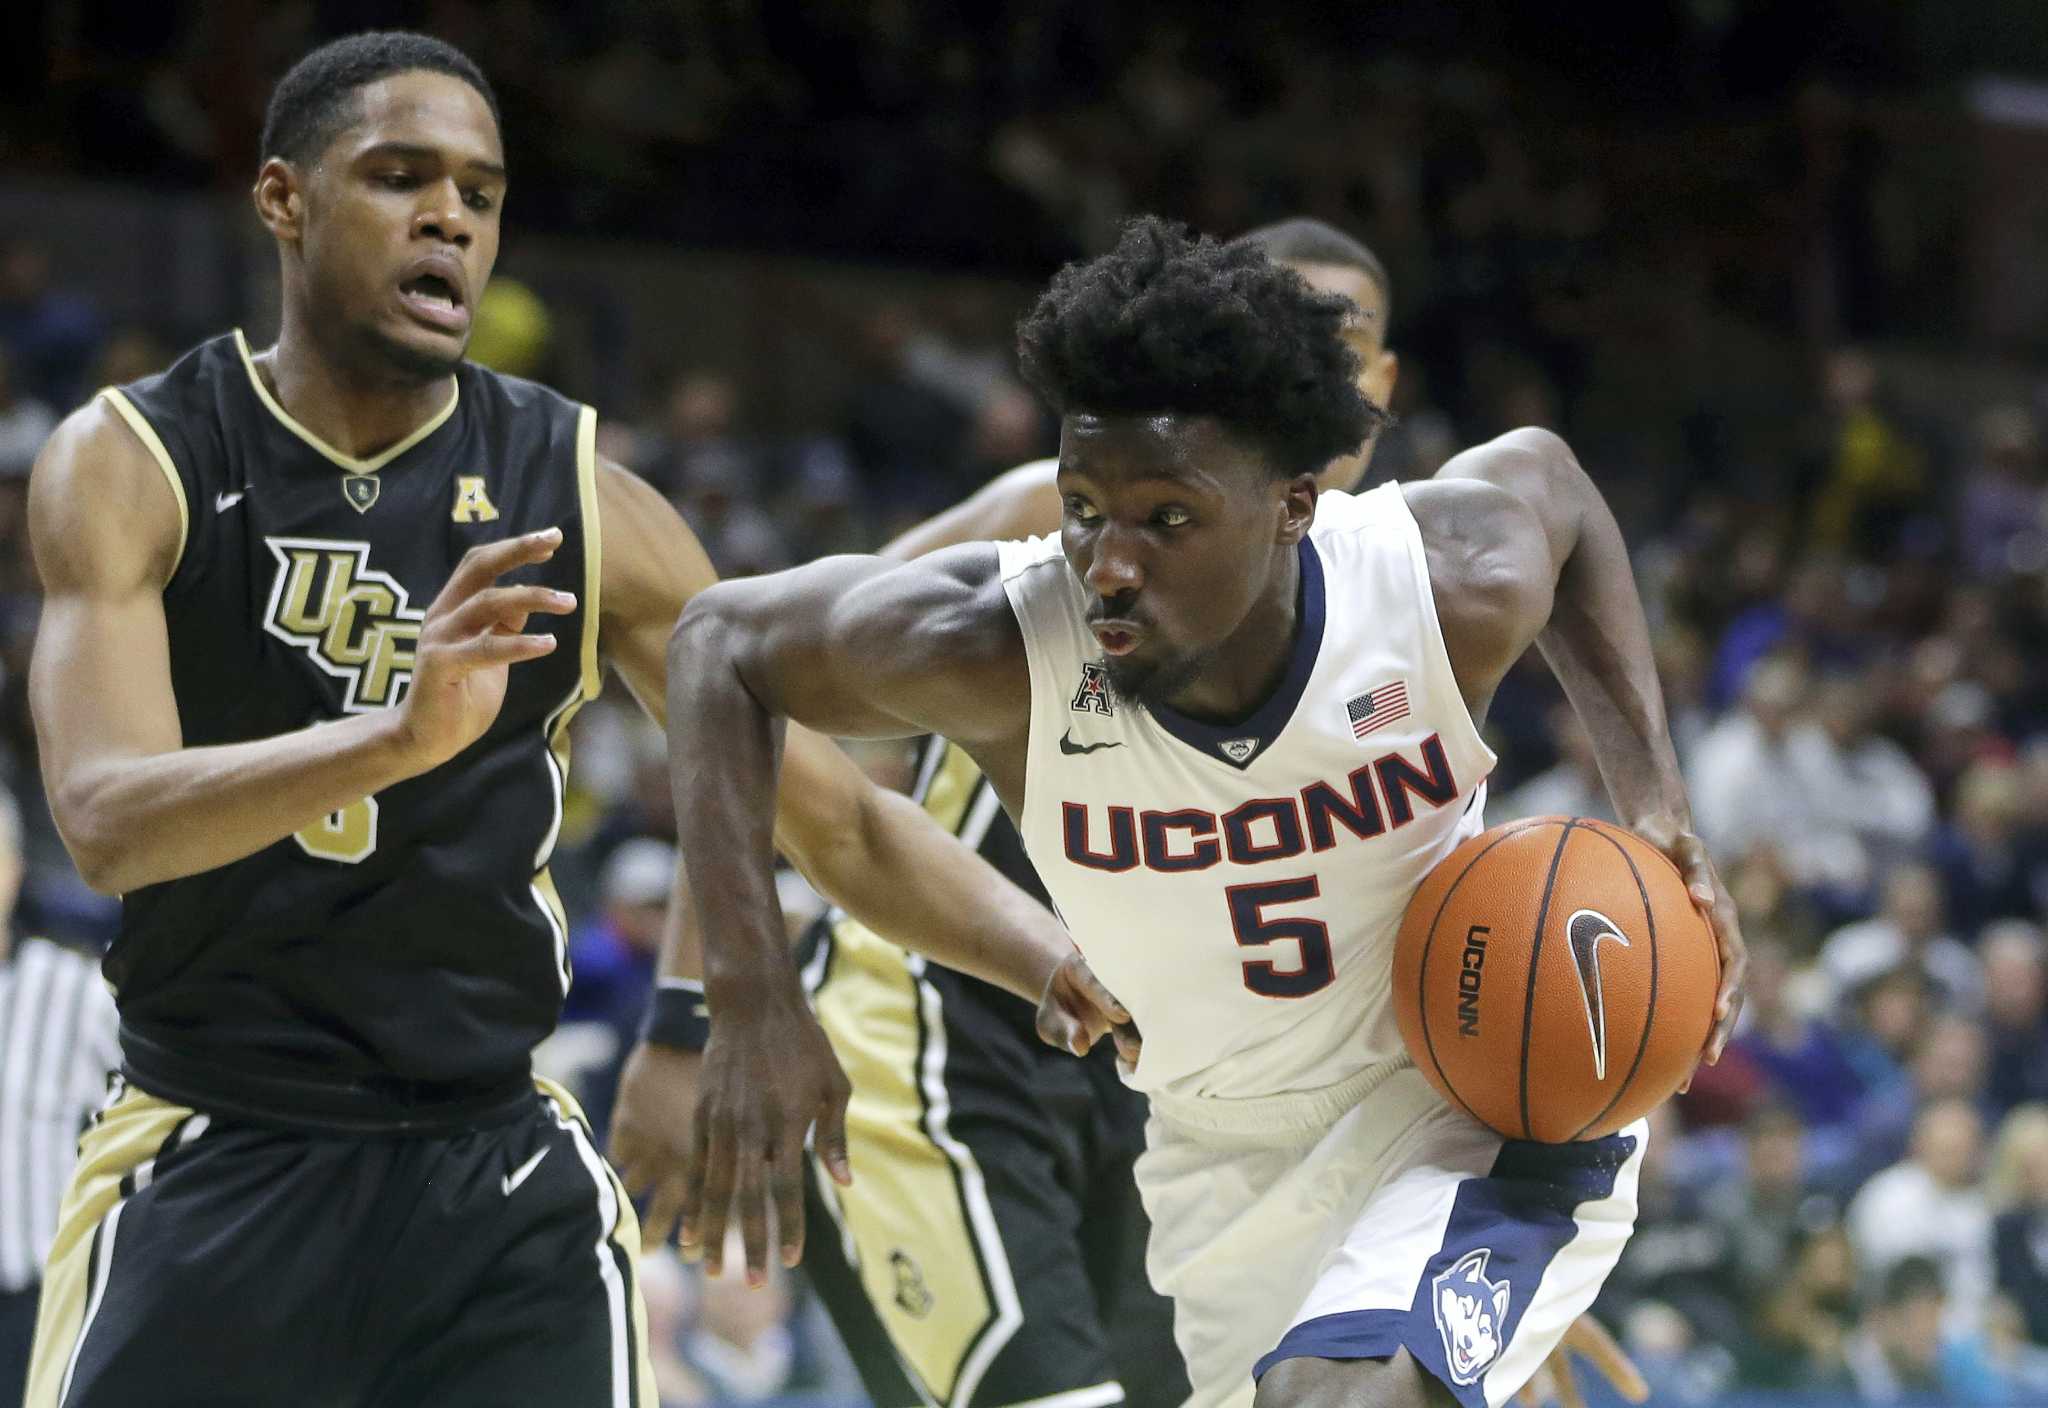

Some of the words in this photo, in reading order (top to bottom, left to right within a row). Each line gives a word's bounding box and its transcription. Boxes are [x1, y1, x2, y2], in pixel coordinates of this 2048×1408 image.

[452, 476, 499, 523] A
[1072, 663, 1114, 716] A
[1062, 733, 1458, 872] UCONN
[1225, 874, 1335, 999] 5
[1459, 925, 1490, 1037] UCONN
